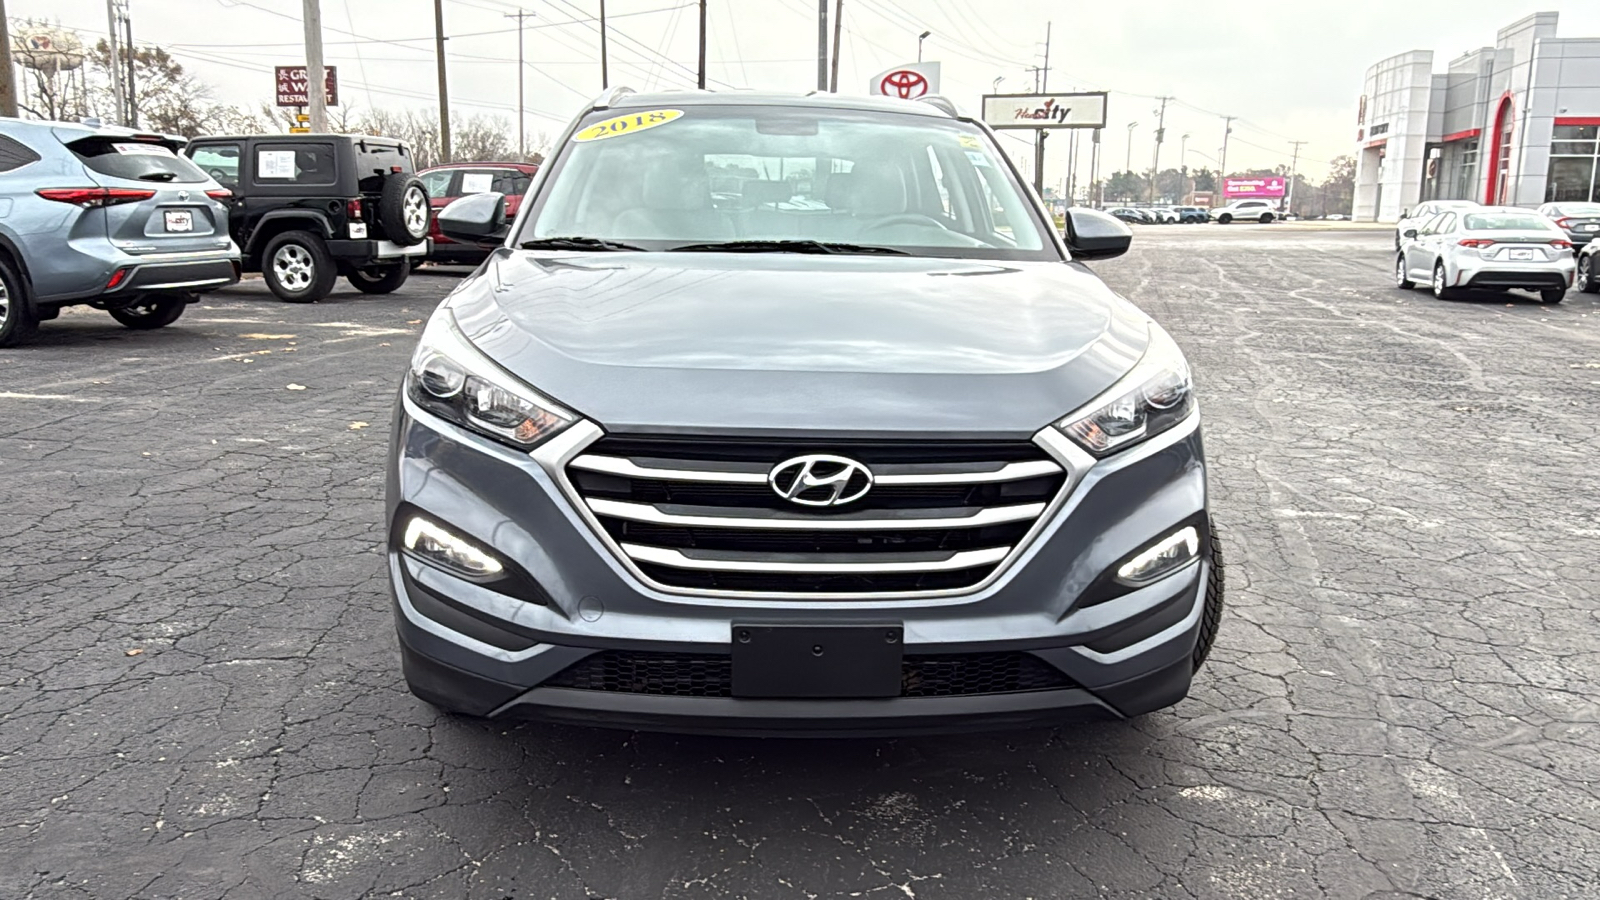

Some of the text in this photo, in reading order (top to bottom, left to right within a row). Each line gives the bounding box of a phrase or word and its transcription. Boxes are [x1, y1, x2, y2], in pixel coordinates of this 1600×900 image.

[289, 69, 331, 80] GRT
[278, 94, 333, 103] RESTAUT
[591, 112, 667, 138] 2018
